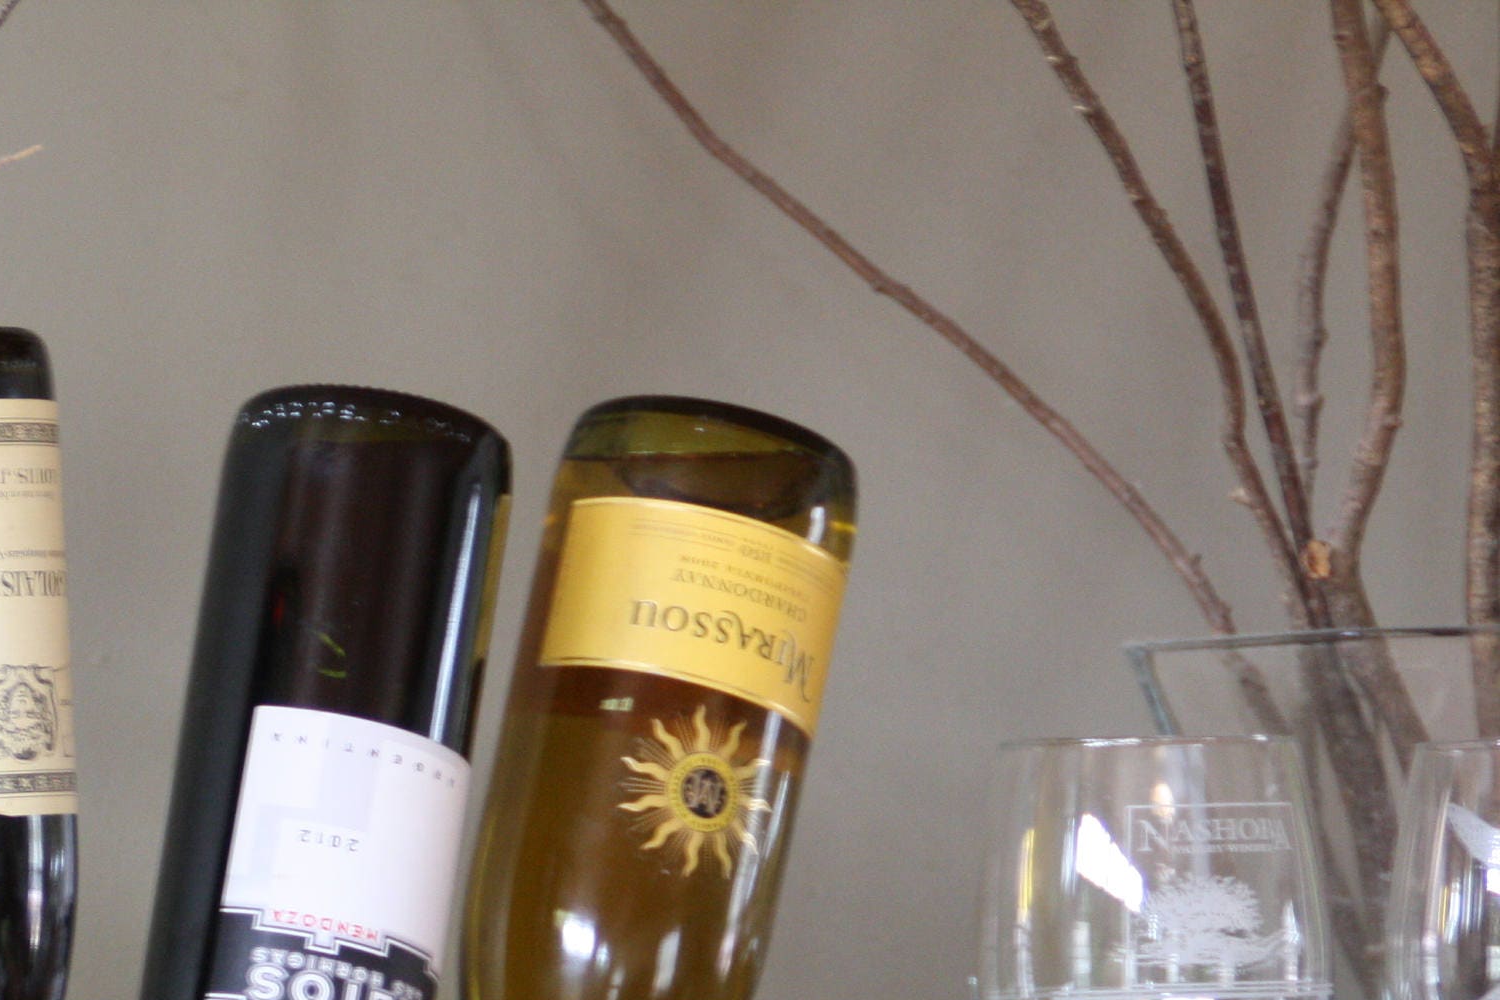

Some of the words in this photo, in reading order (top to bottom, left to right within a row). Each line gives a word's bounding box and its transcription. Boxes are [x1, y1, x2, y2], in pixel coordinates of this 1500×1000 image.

[669, 569, 807, 623] CHARDONNAY
[270, 732, 456, 789] ARGENTINA
[296, 829, 360, 852] 2012
[271, 908, 379, 941] MENDOZA
[249, 947, 384, 986] HORMIGAS
